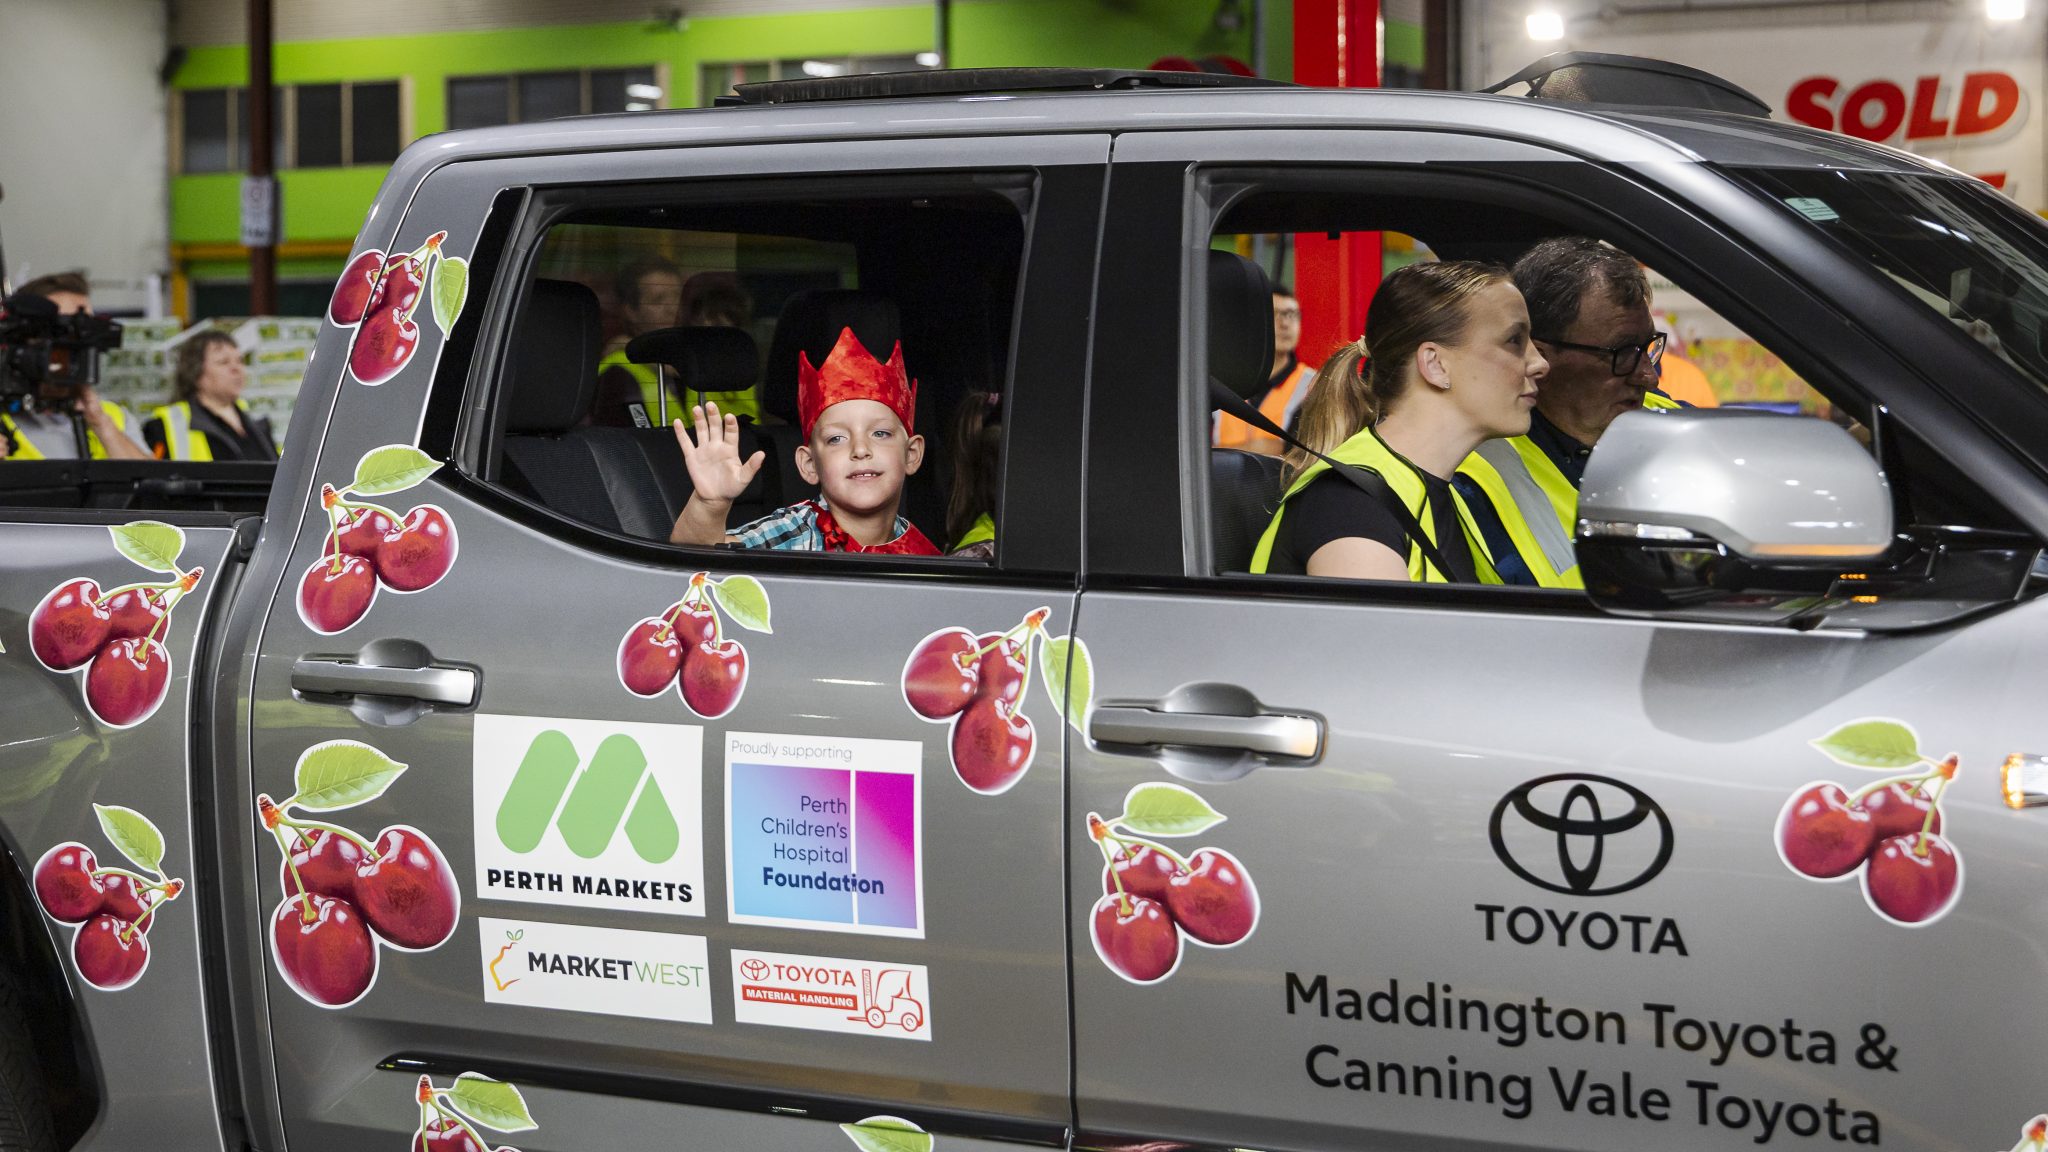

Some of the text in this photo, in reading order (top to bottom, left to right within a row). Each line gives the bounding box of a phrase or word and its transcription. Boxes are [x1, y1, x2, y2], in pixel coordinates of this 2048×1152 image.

[1786, 71, 2019, 143] SOLD
[731, 740, 853, 762] Proudly supporting
[800, 795, 848, 815] Perth
[761, 817, 848, 840] Children's
[774, 843, 849, 866] Hospital
[487, 868, 693, 903] PERTH MARKETS
[763, 867, 885, 896] Foundation
[1475, 903, 1689, 957] TOYOTA
[527, 951, 705, 989] MARKETWEST
[773, 964, 857, 988] TOYOTA
[745, 988, 854, 1008] MATERIAL HANDLING
[1285, 972, 1899, 1072] Maddington Toyota &
[1305, 1044, 1881, 1145] Canning Vale Toyota
